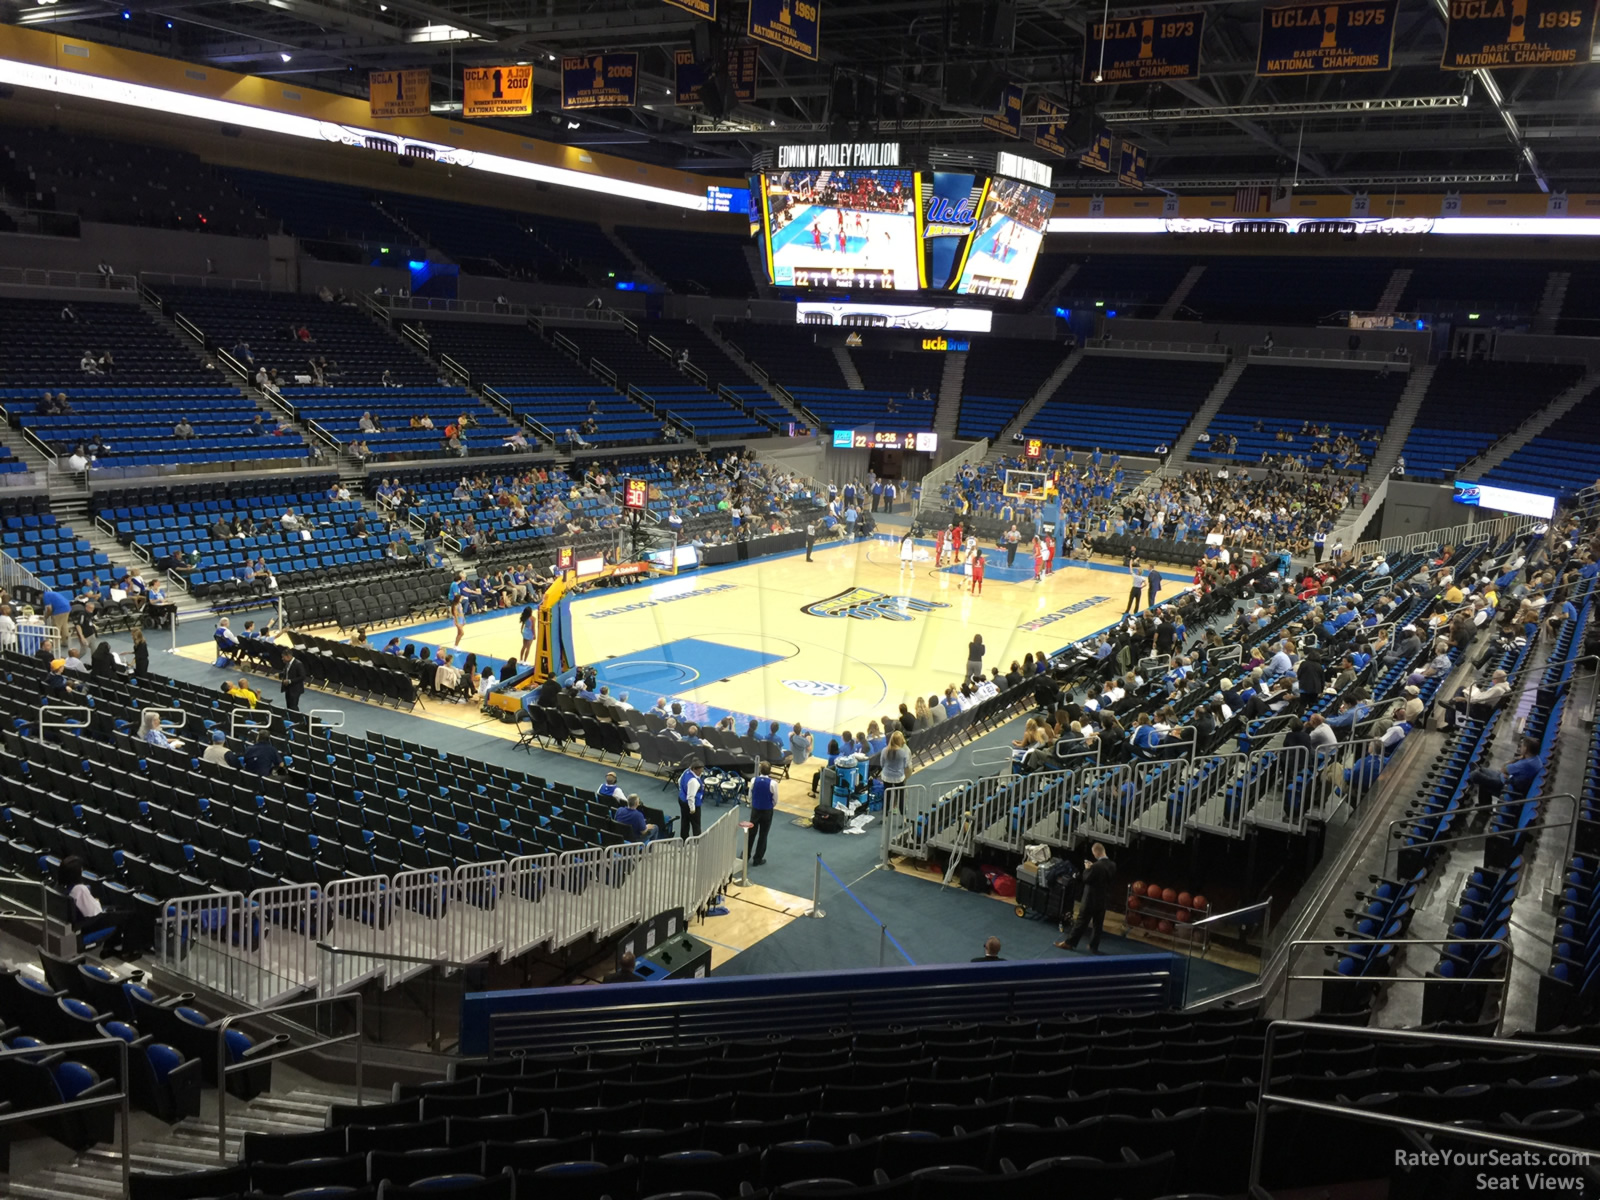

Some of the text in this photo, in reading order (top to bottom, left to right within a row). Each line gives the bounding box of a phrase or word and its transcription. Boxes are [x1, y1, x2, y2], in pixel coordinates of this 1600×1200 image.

[795, 0, 816, 22] 1969
[1272, 9, 1321, 28] UCLA
[1347, 8, 1385, 26] 1975
[1451, 1, 1505, 19] UCLA
[1538, 11, 1582, 28] 1995
[1093, 22, 1137, 40] UCLA
[1161, 22, 1194, 38] 1973
[754, 24, 812, 55] NATIONAL CHAMPIONS
[1293, 48, 1355, 58] BASKETBALL
[1483, 42, 1550, 53] BASKETBALL
[1113, 58, 1168, 69] BASKETBALL
[1267, 55, 1379, 71] NATIONAL CHAMPIONS
[1456, 49, 1577, 65] NATIONAL CHAMPIONS
[564, 59, 589, 70] UCLA
[608, 65, 632, 78] 2006
[1139, 64, 1189, 77] CHAMPIONS
[371, 72, 393, 84] UCLA
[465, 71, 488, 81] UCLA
[507, 78, 528, 89] 2010
[568, 96, 596, 105] NATIONAL
[778, 142, 899, 168] EDWIN W PAULEY PAVILION
[927, 196, 976, 225] Ucla
[1355, 201, 1366, 210] 32
[1446, 201, 1457, 210] 33
[1553, 201, 1562, 210] 11
[795, 271, 809, 286] 22
[881, 274, 892, 288] 12
[855, 436, 867, 447] 22
[904, 438, 914, 449] 12
[1028, 447, 1039, 456] 30
[630, 480, 646, 491] 6:25
[628, 490, 643, 505] 30
[561, 556, 570, 566] 30
